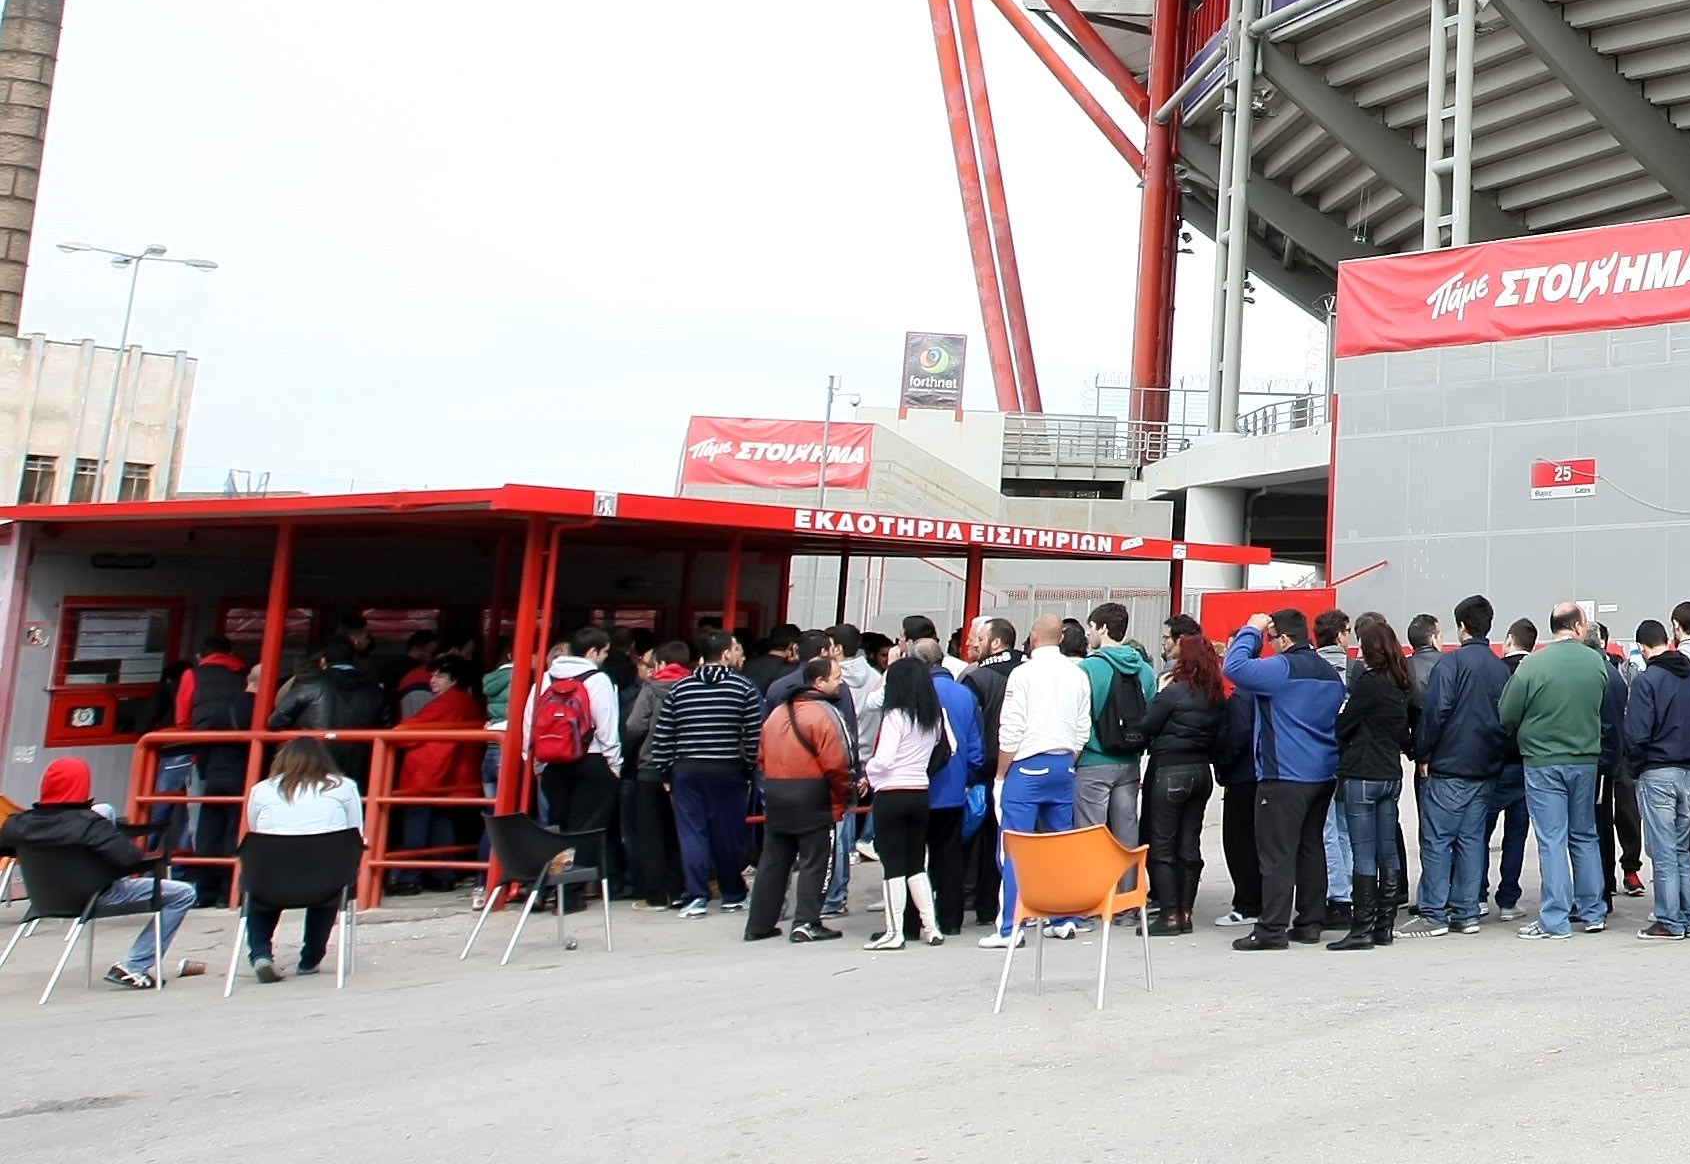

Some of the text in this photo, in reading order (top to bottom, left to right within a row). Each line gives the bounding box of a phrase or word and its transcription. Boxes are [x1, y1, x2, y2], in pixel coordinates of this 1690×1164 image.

[1426, 271, 1489, 321] Πάμε
[909, 376, 957, 389] forthnet
[1554, 465, 1572, 482] 25
[794, 509, 962, 542] ΕΚΔΟΤΗΡΙΑ
[970, 524, 1112, 553] ΕΙΣΙΤΗΡΙΩΝ
